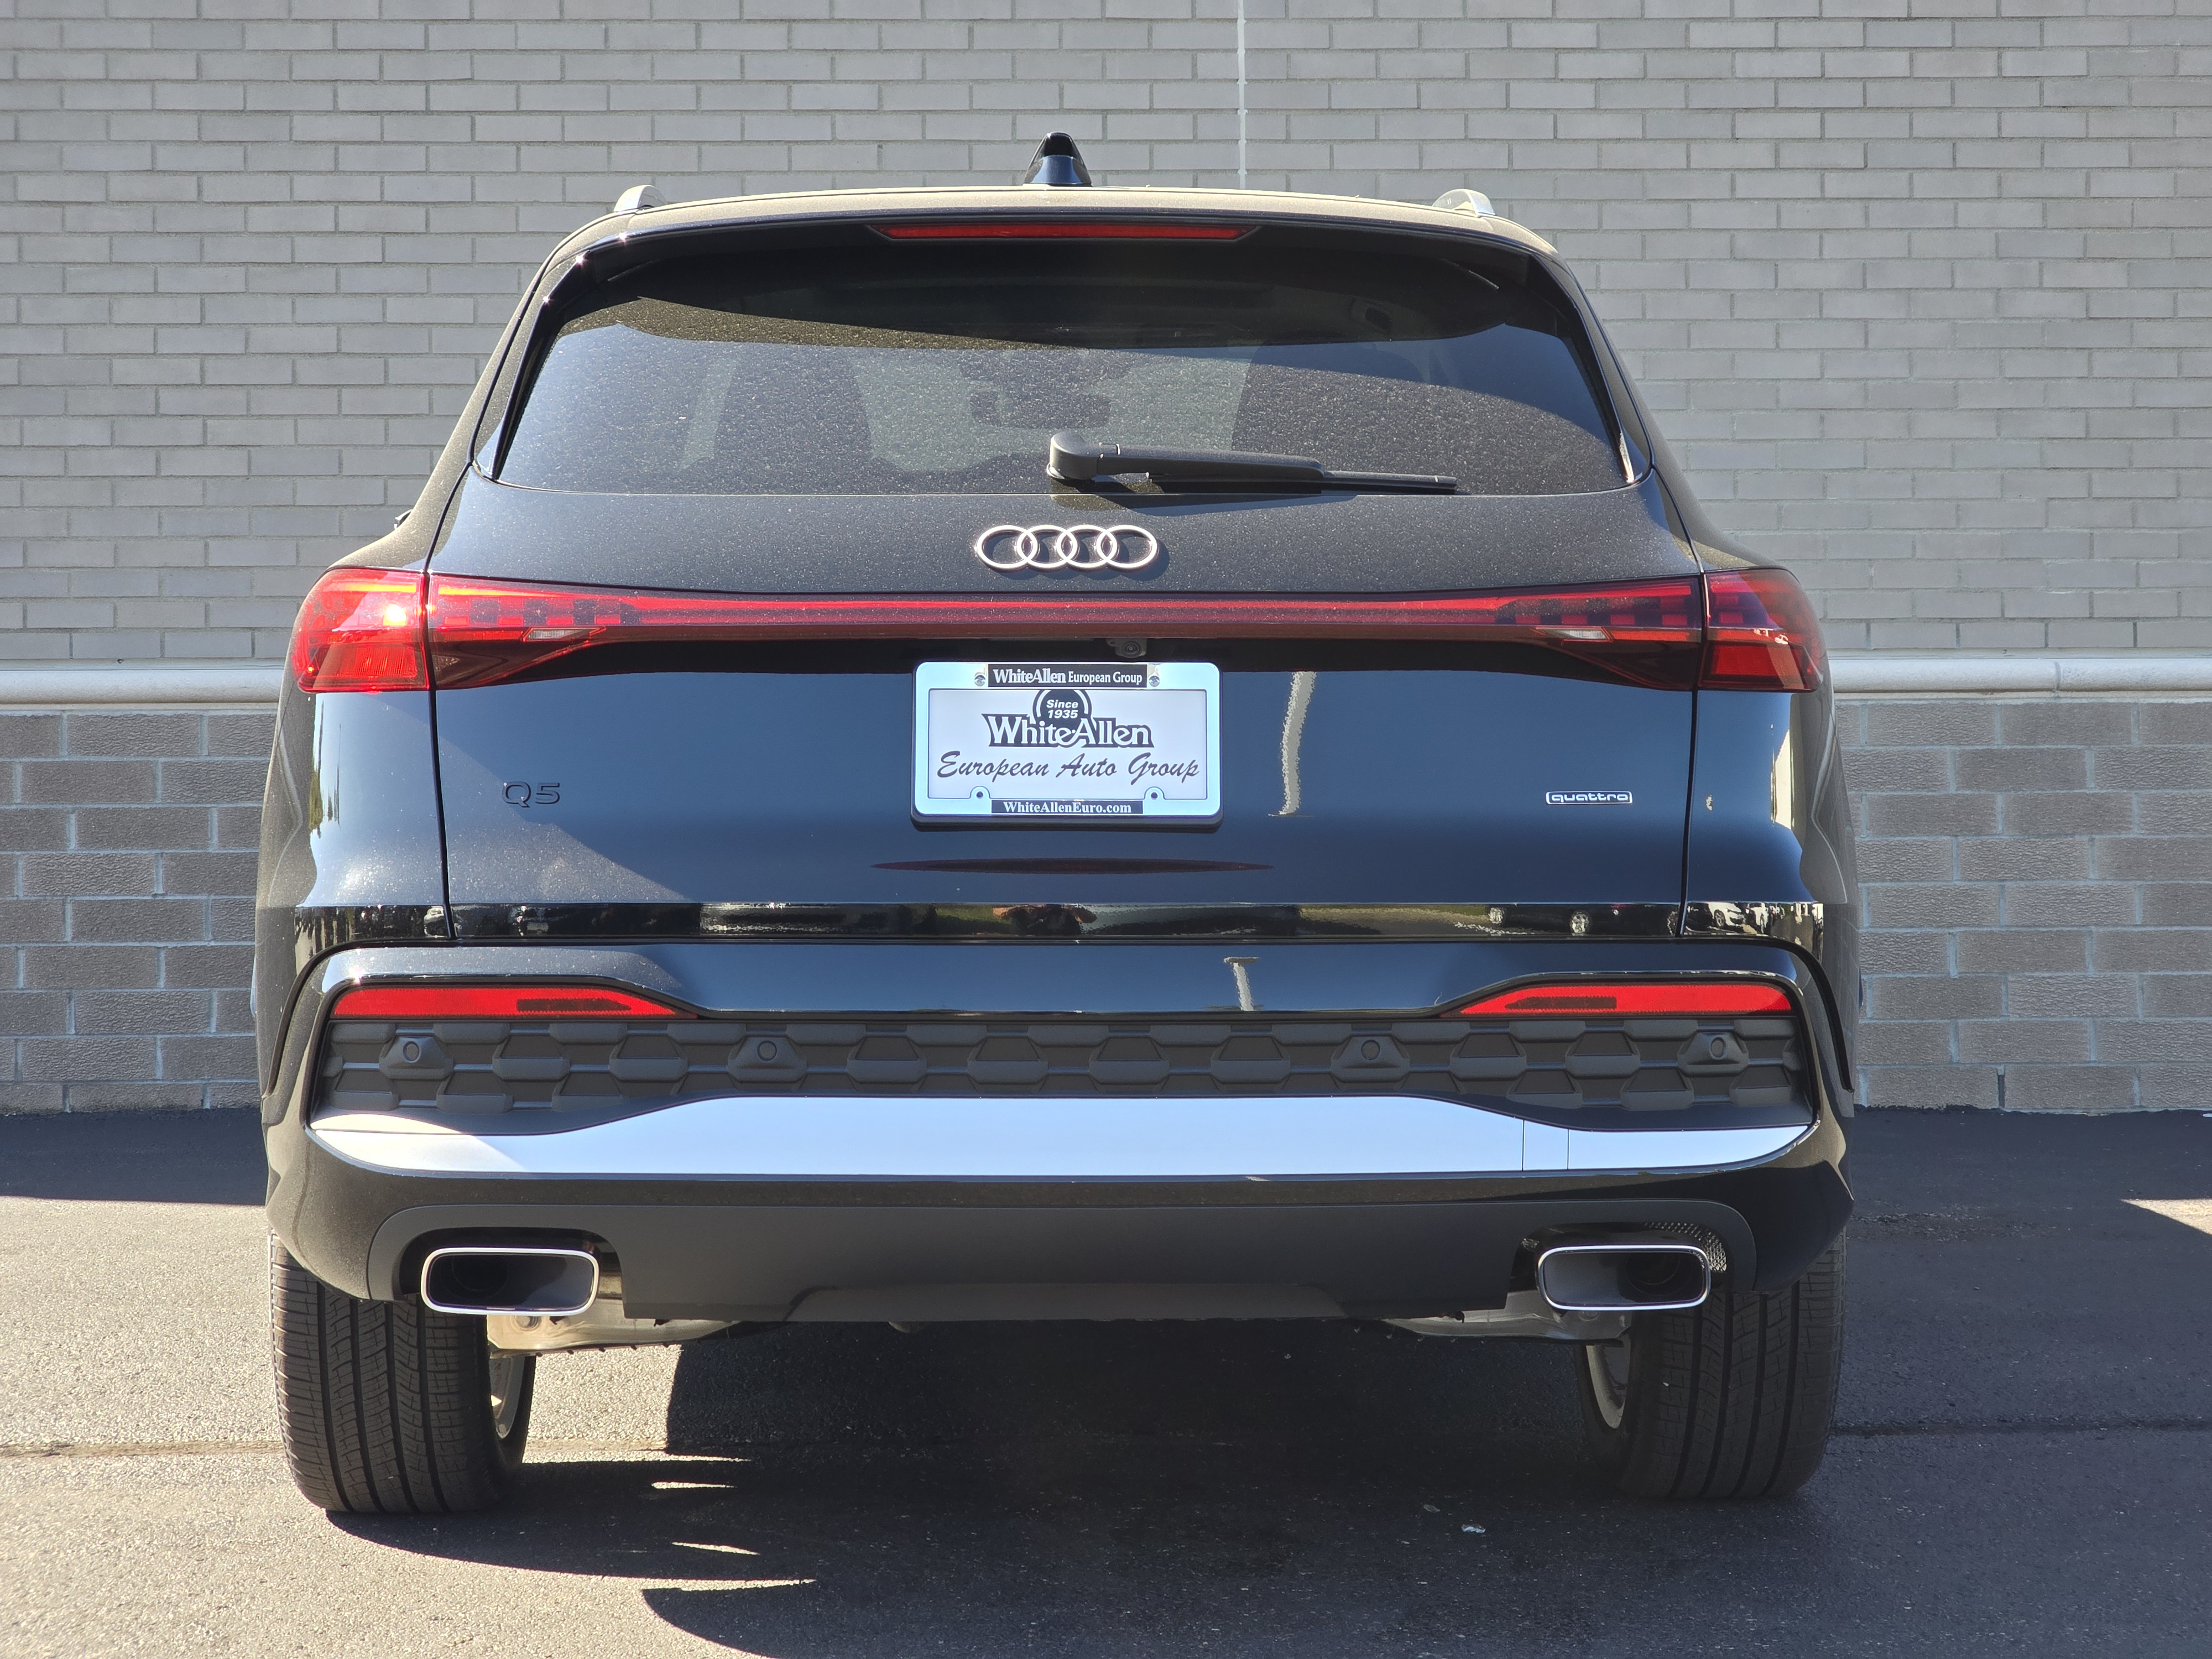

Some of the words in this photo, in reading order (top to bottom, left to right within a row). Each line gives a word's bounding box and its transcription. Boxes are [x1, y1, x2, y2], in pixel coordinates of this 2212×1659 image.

[993, 668, 1067, 684] WhiteAllen
[1068, 671, 1111, 685] European
[1113, 671, 1142, 685] Group
[1046, 699, 1078, 708] Since
[1048, 709, 1078, 718] 1935
[937, 750, 1050, 782] European
[1055, 753, 1117, 778] Auto
[1128, 752, 1200, 785] Group
[502, 781, 560, 808] Q5
[1551, 792, 1629, 803] quattro
[1003, 802, 1132, 813] WhiteAllenEuro.com
